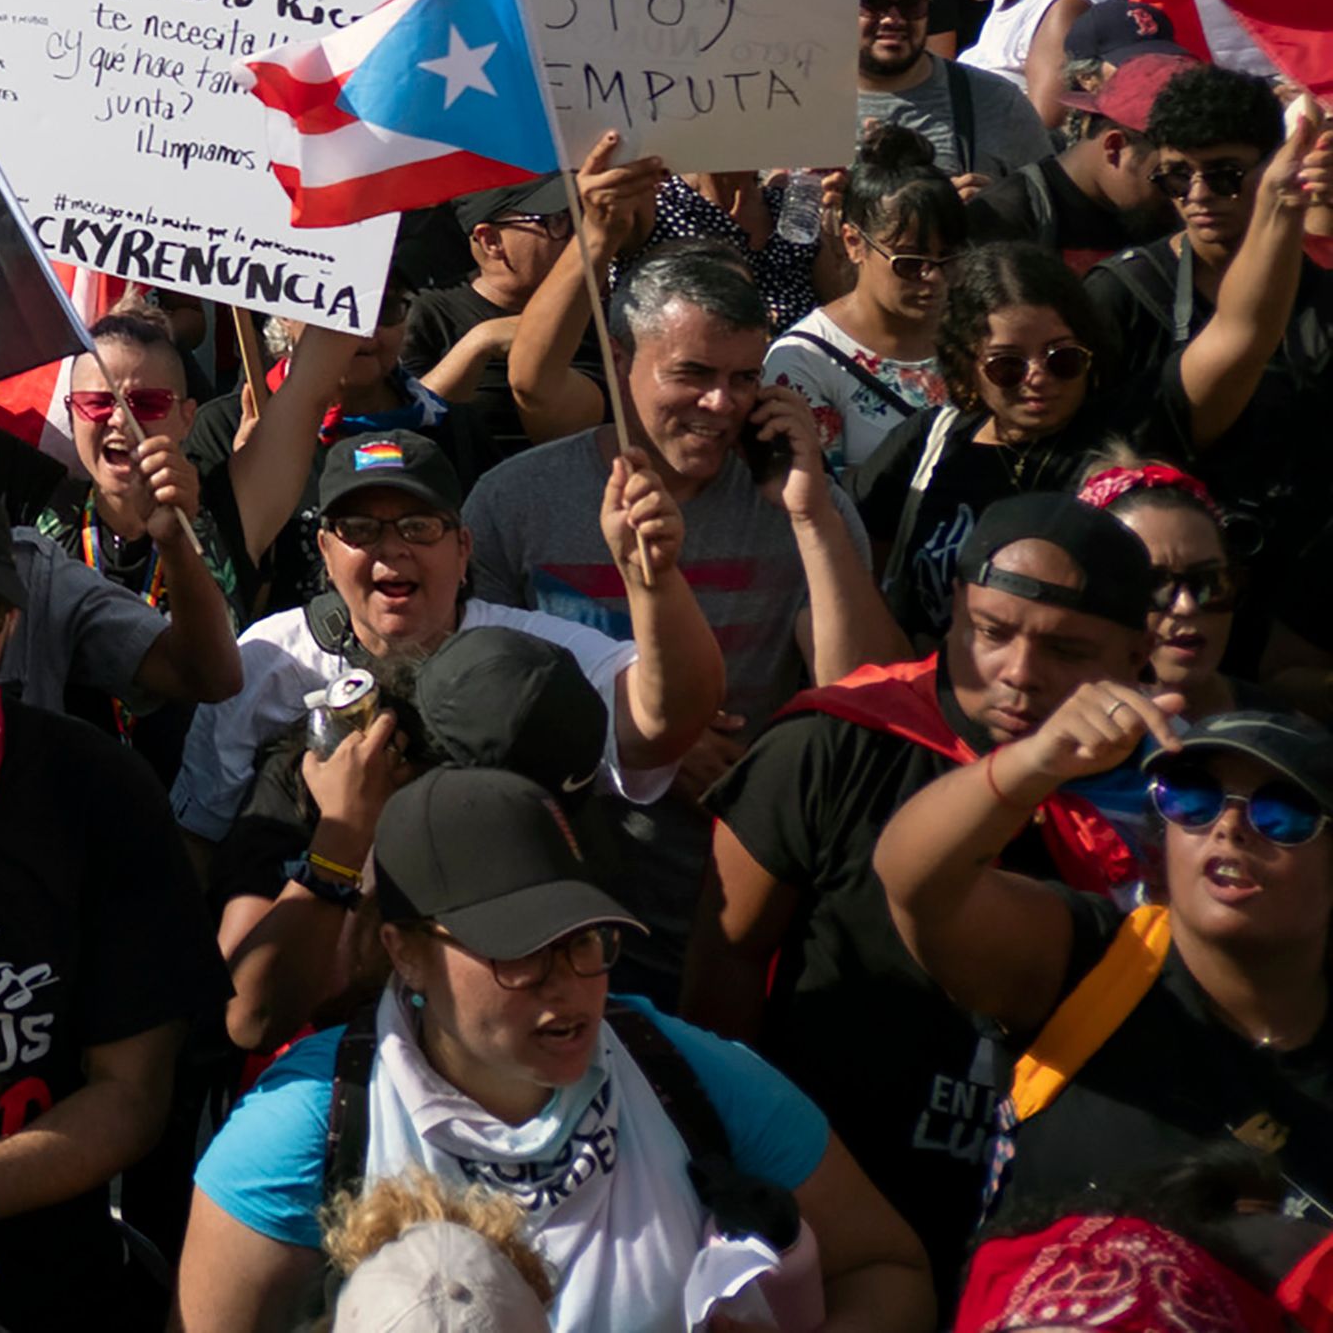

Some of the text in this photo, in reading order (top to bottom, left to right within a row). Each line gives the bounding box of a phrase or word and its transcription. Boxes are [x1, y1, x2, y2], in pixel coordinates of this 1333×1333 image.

[91, 2, 133, 32] te
[89, 41, 126, 87] qué
[133, 47, 188, 87] hace
[95, 87, 193, 121] junta?
[32, 215, 361, 330] CKYRENUNCIA
